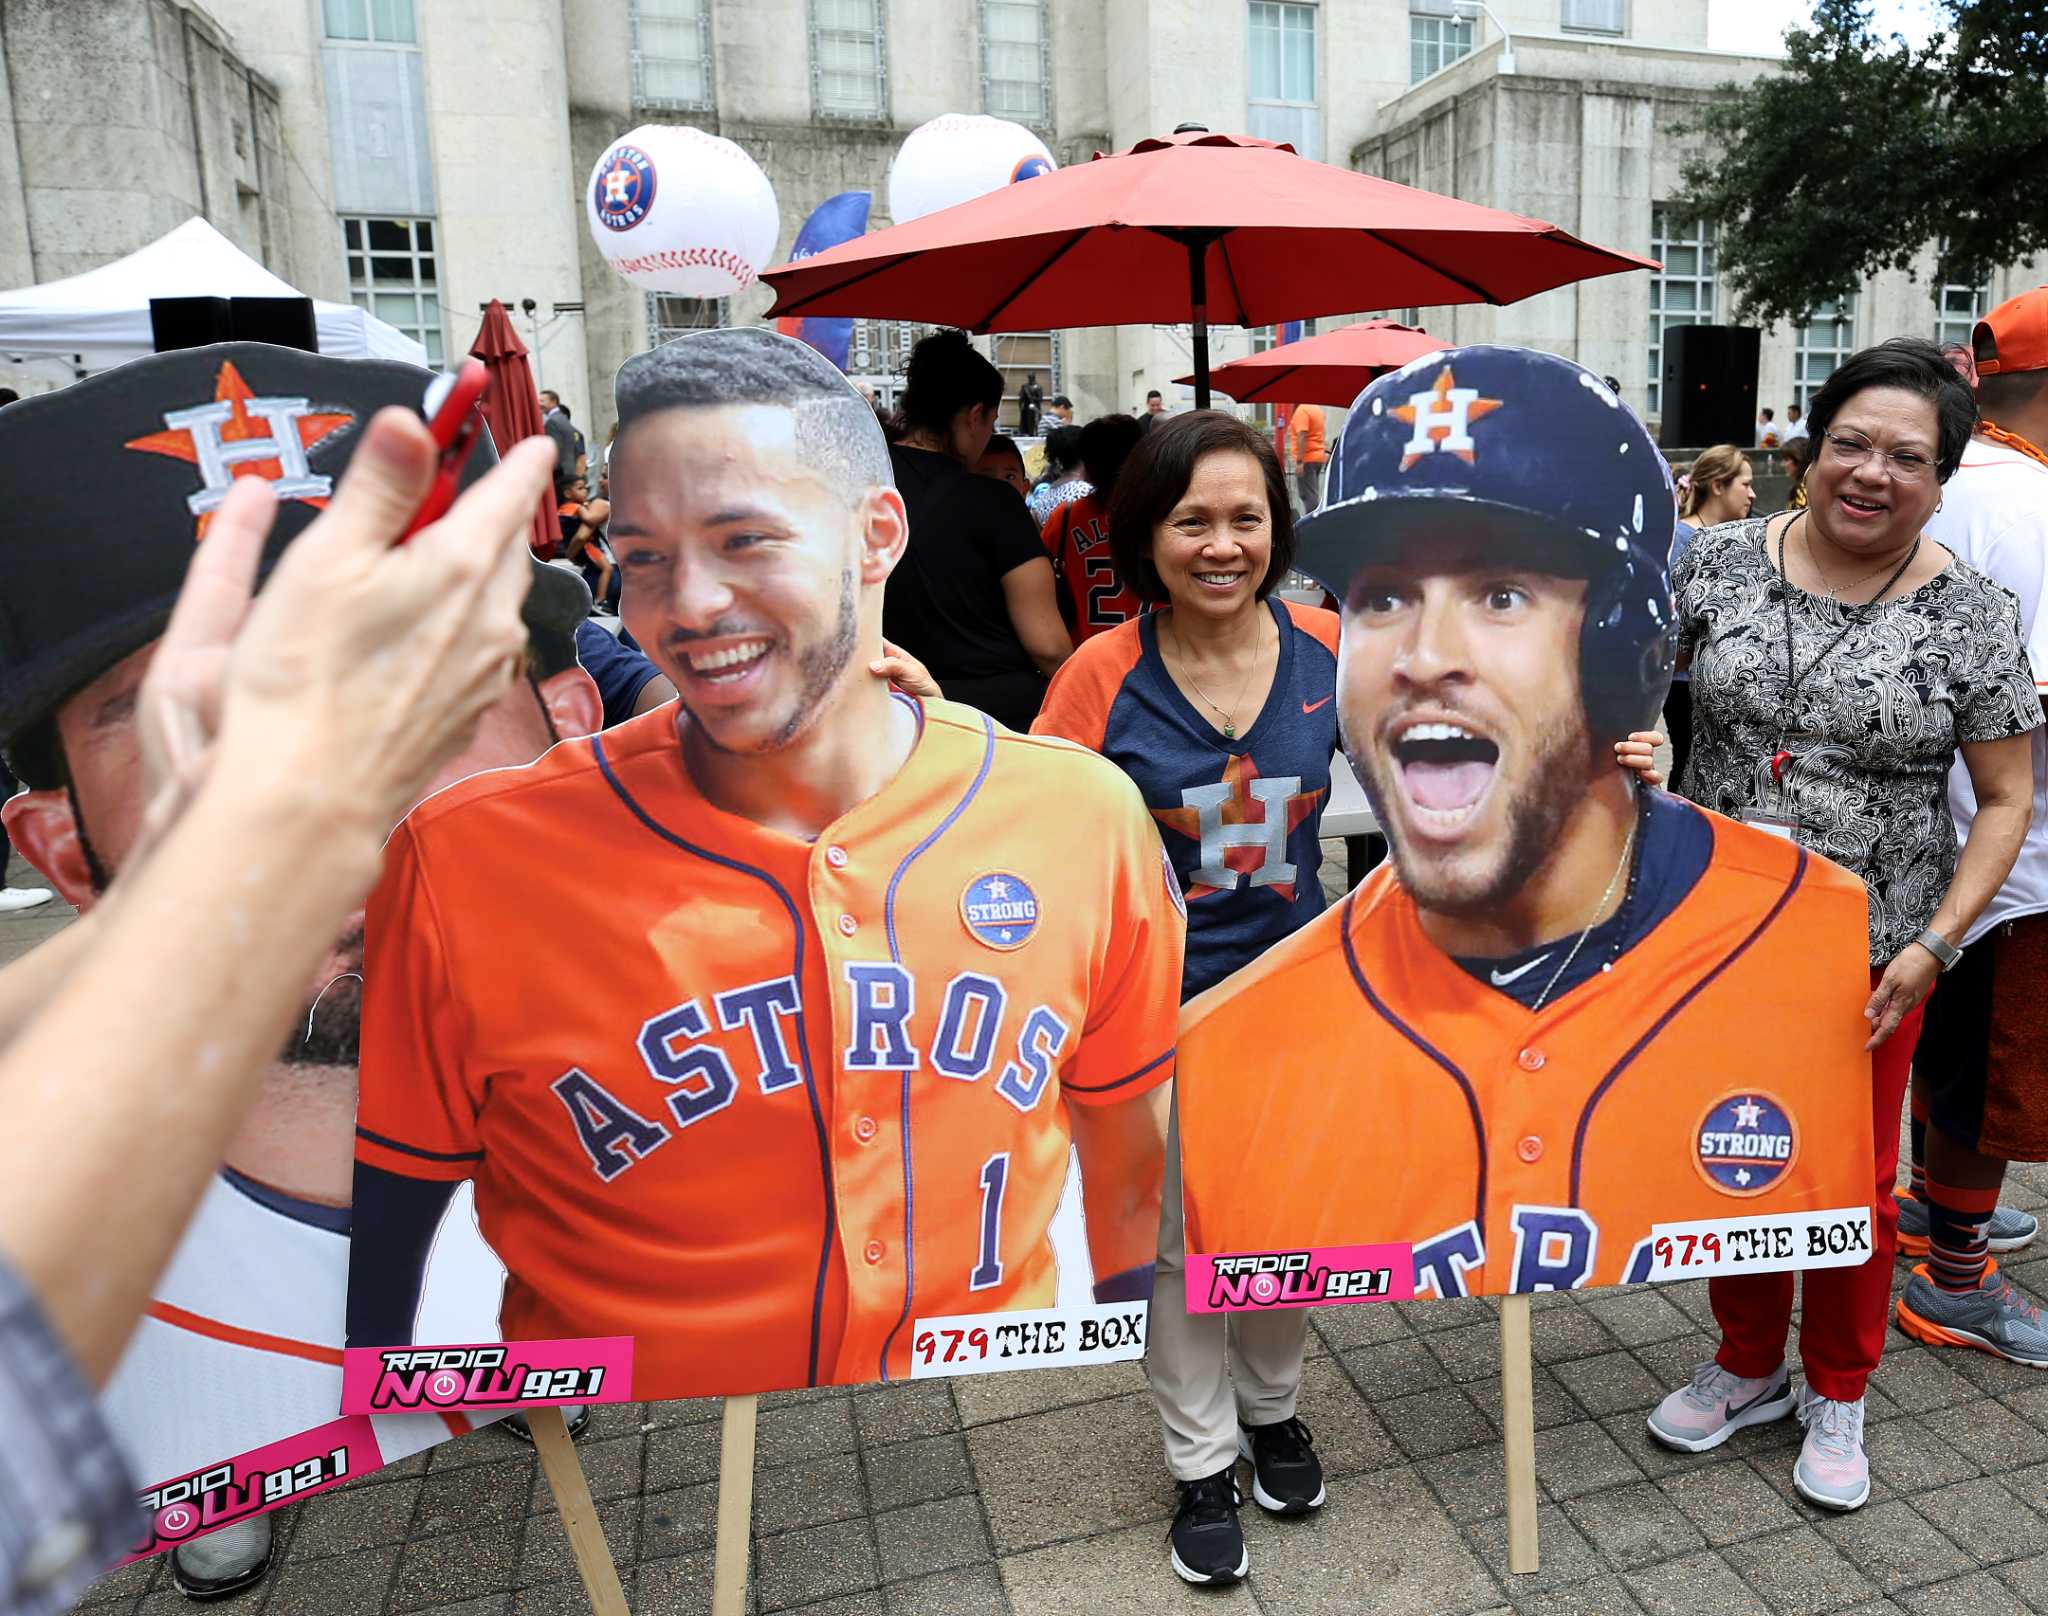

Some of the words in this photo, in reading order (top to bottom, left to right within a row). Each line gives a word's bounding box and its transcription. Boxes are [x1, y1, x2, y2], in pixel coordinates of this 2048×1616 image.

[1404, 388, 1479, 455] H
[164, 397, 332, 516] H
[1072, 518, 1109, 554] AL
[1181, 776, 1302, 889] H
[968, 900, 1036, 921] STRONG
[550, 961, 1069, 1182] ASTROS
[1700, 1132, 1791, 1158] STRONG
[969, 1152, 1009, 1292] 1
[1655, 1233, 1721, 1268] 97.9
[1727, 1227, 1794, 1261] THE
[1807, 1220, 1869, 1256] BOX
[1214, 1254, 1309, 1275] RADIO
[1412, 1204, 1653, 1299] TR
[1210, 1270, 1328, 1304] NOW
[1325, 1270, 1391, 1297] 92.1
[383, 1349, 505, 1371] RADIO
[915, 1327, 988, 1365] 97.9
[996, 1321, 1066, 1357] THE
[1079, 1314, 1143, 1351] BOX
[373, 1366, 527, 1405] NOW
[521, 1368, 603, 1398] 92.1
[138, 1465, 232, 1510] ADIO
[264, 1447, 348, 1503] 92.1
